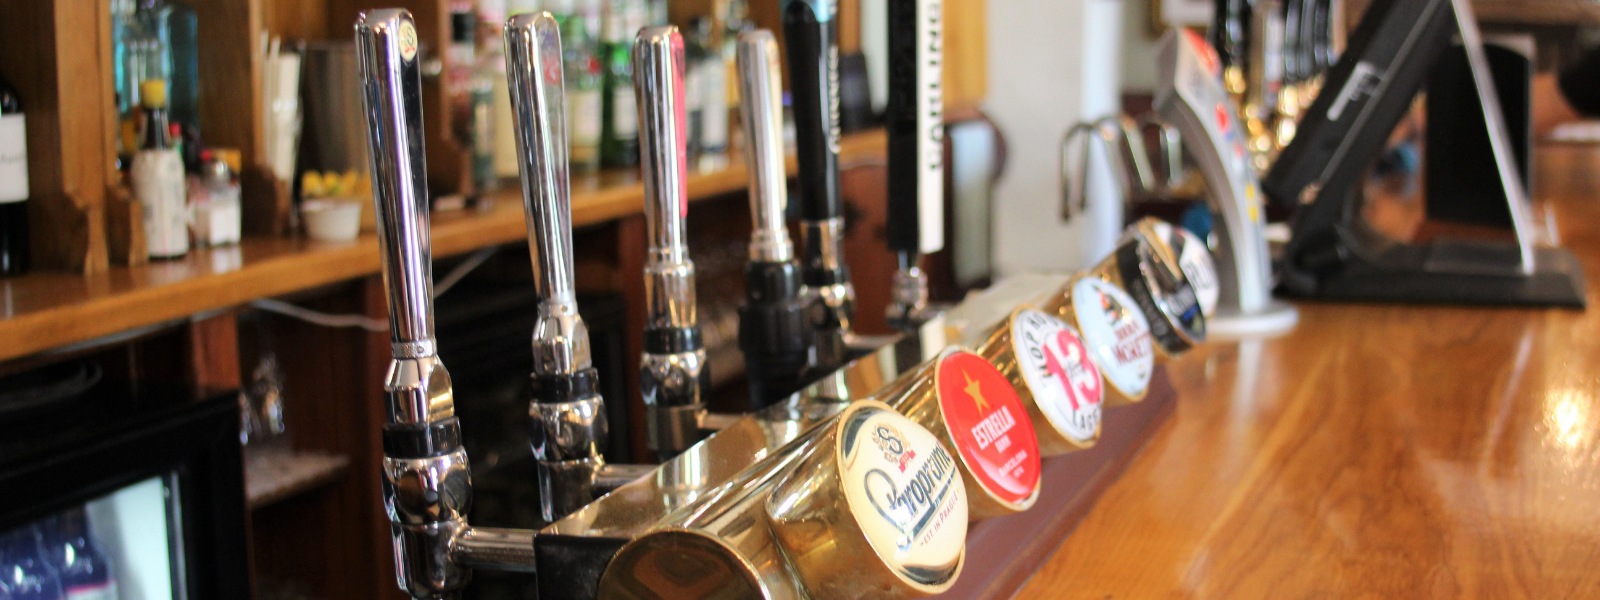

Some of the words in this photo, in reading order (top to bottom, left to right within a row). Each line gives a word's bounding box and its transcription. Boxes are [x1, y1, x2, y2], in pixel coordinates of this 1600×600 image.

[1042, 329, 1101, 411] 13
[971, 405, 1016, 450] ESTRELLA
[998, 450, 1027, 477] BARCELONA
[940, 493, 959, 522] PRAGUE
